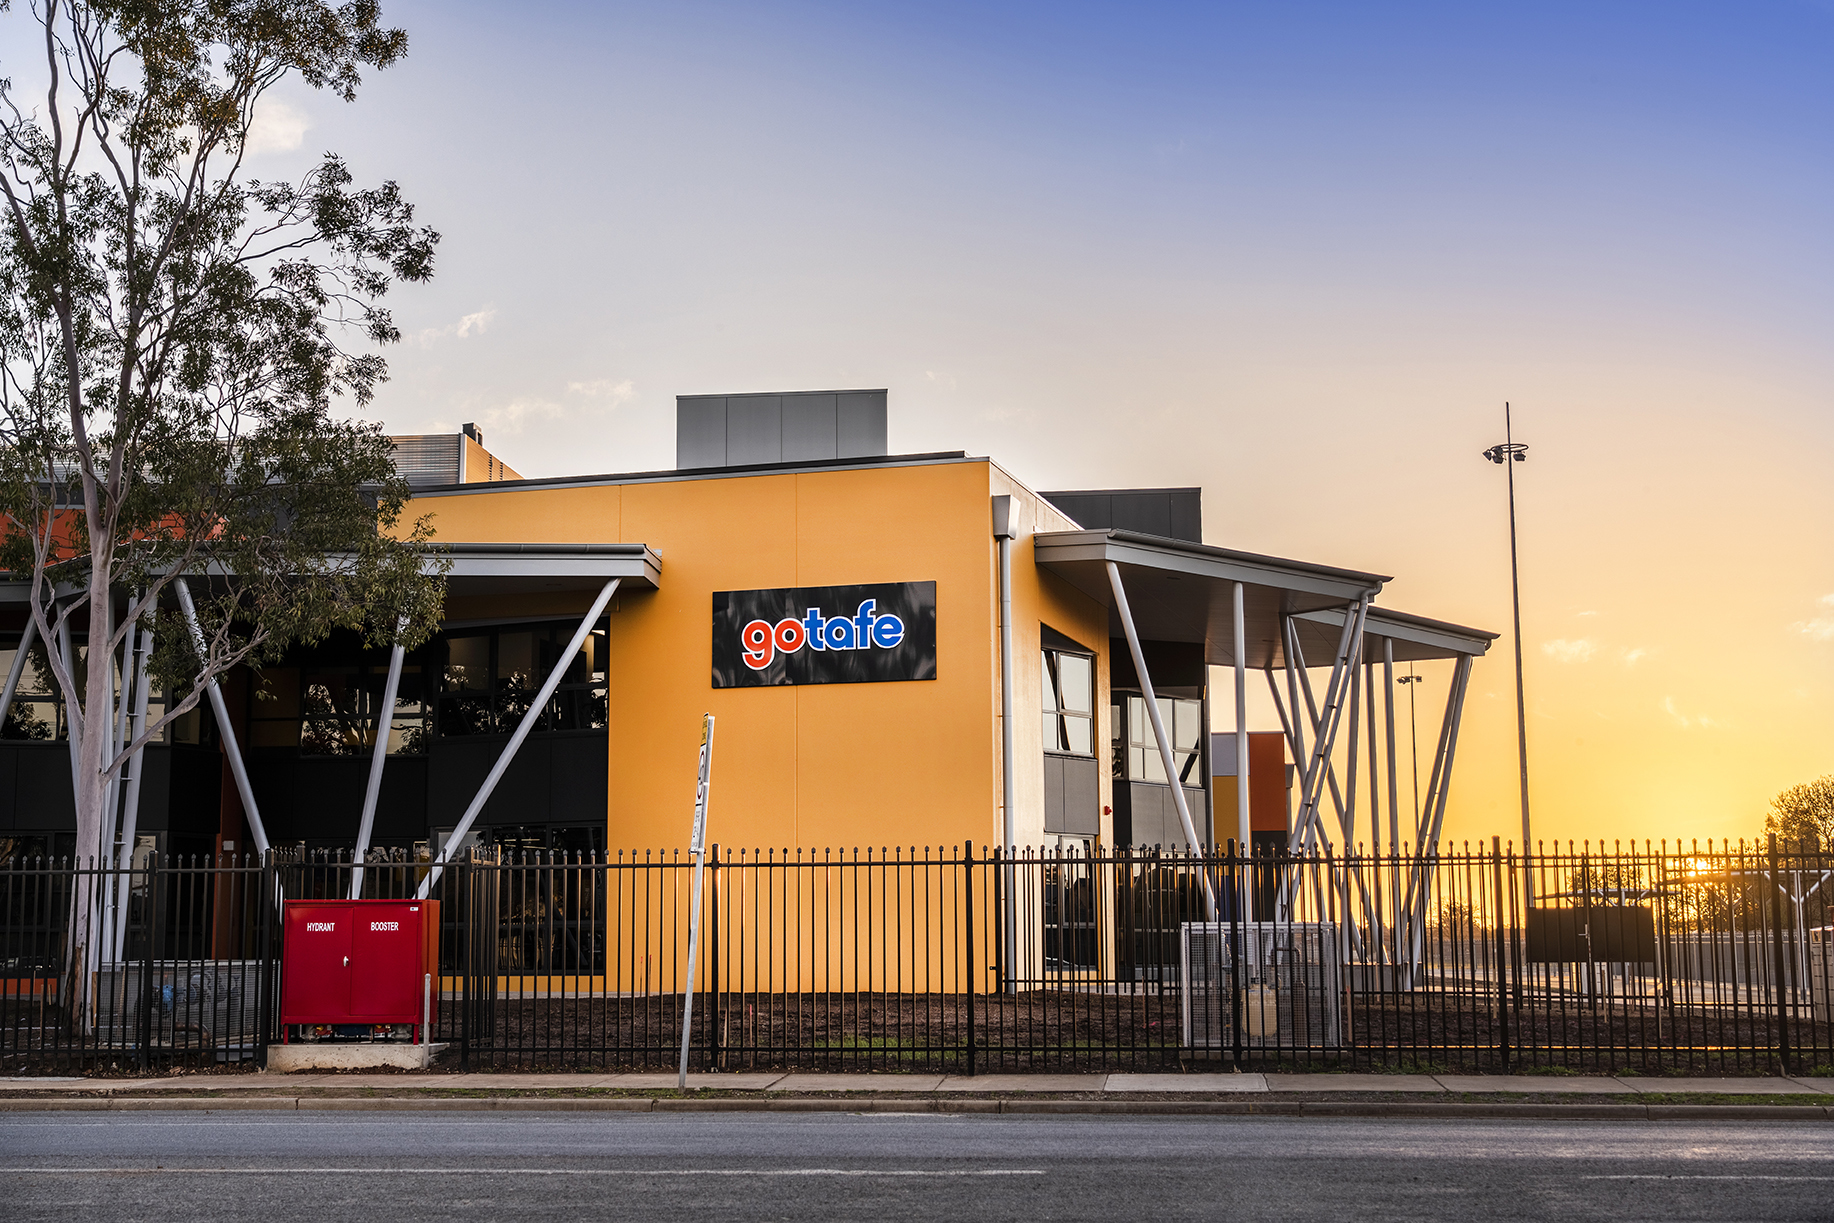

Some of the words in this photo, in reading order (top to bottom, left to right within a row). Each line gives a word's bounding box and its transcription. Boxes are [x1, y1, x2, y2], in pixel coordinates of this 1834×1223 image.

[742, 599, 905, 671] gotafe
[307, 922, 335, 932] HYDRANT
[371, 922, 399, 931] BOOSTER
